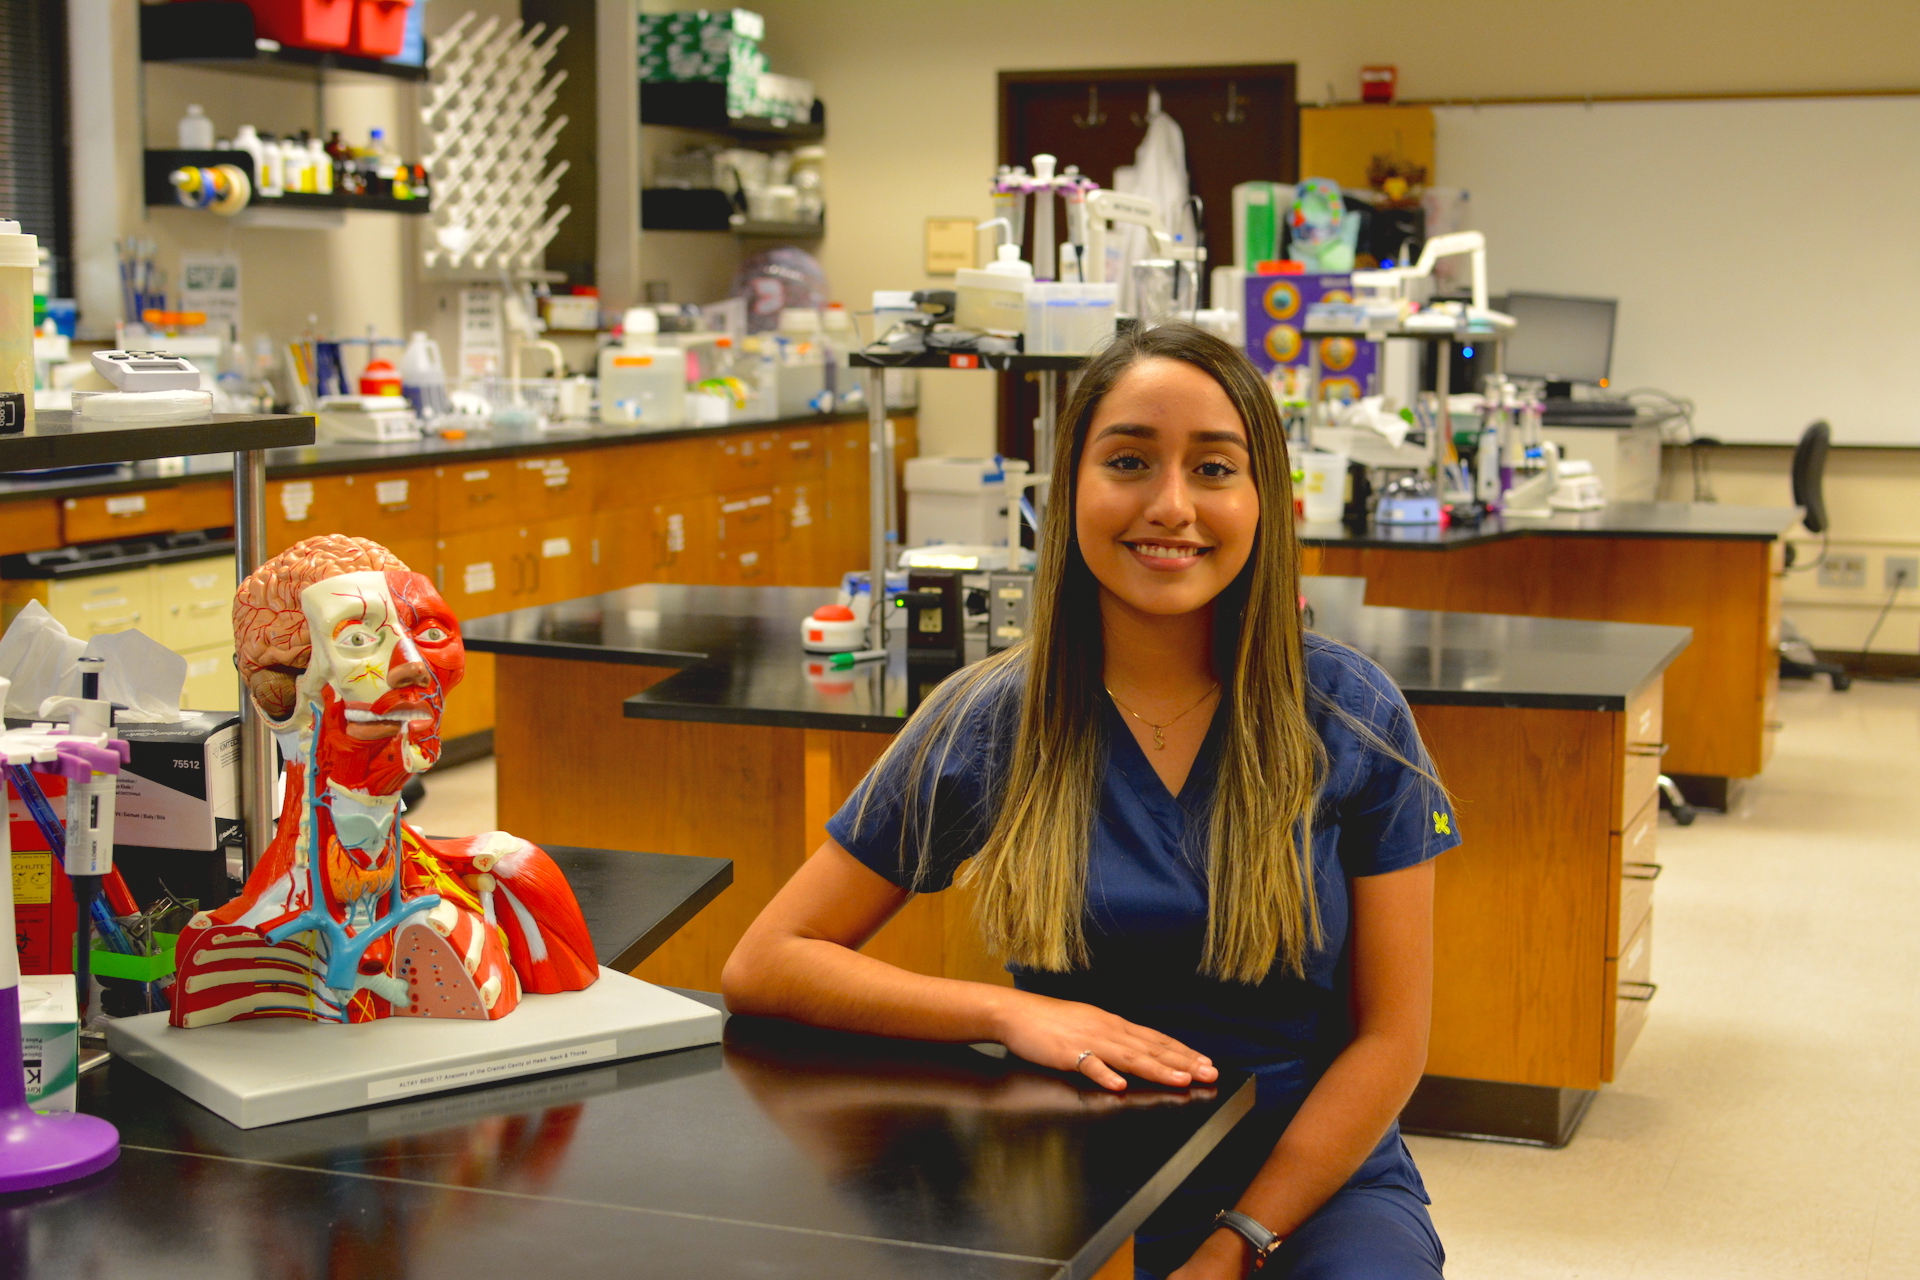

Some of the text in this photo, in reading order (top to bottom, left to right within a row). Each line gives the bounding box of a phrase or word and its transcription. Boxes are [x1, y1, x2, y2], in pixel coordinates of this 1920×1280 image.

[172, 759, 200, 770] 75512
[399, 1079, 419, 1088] ALTAY
[444, 1071, 469, 1080] Anatomy
[486, 1064, 506, 1073] Cranial
[507, 1061, 525, 1069] Cavity
